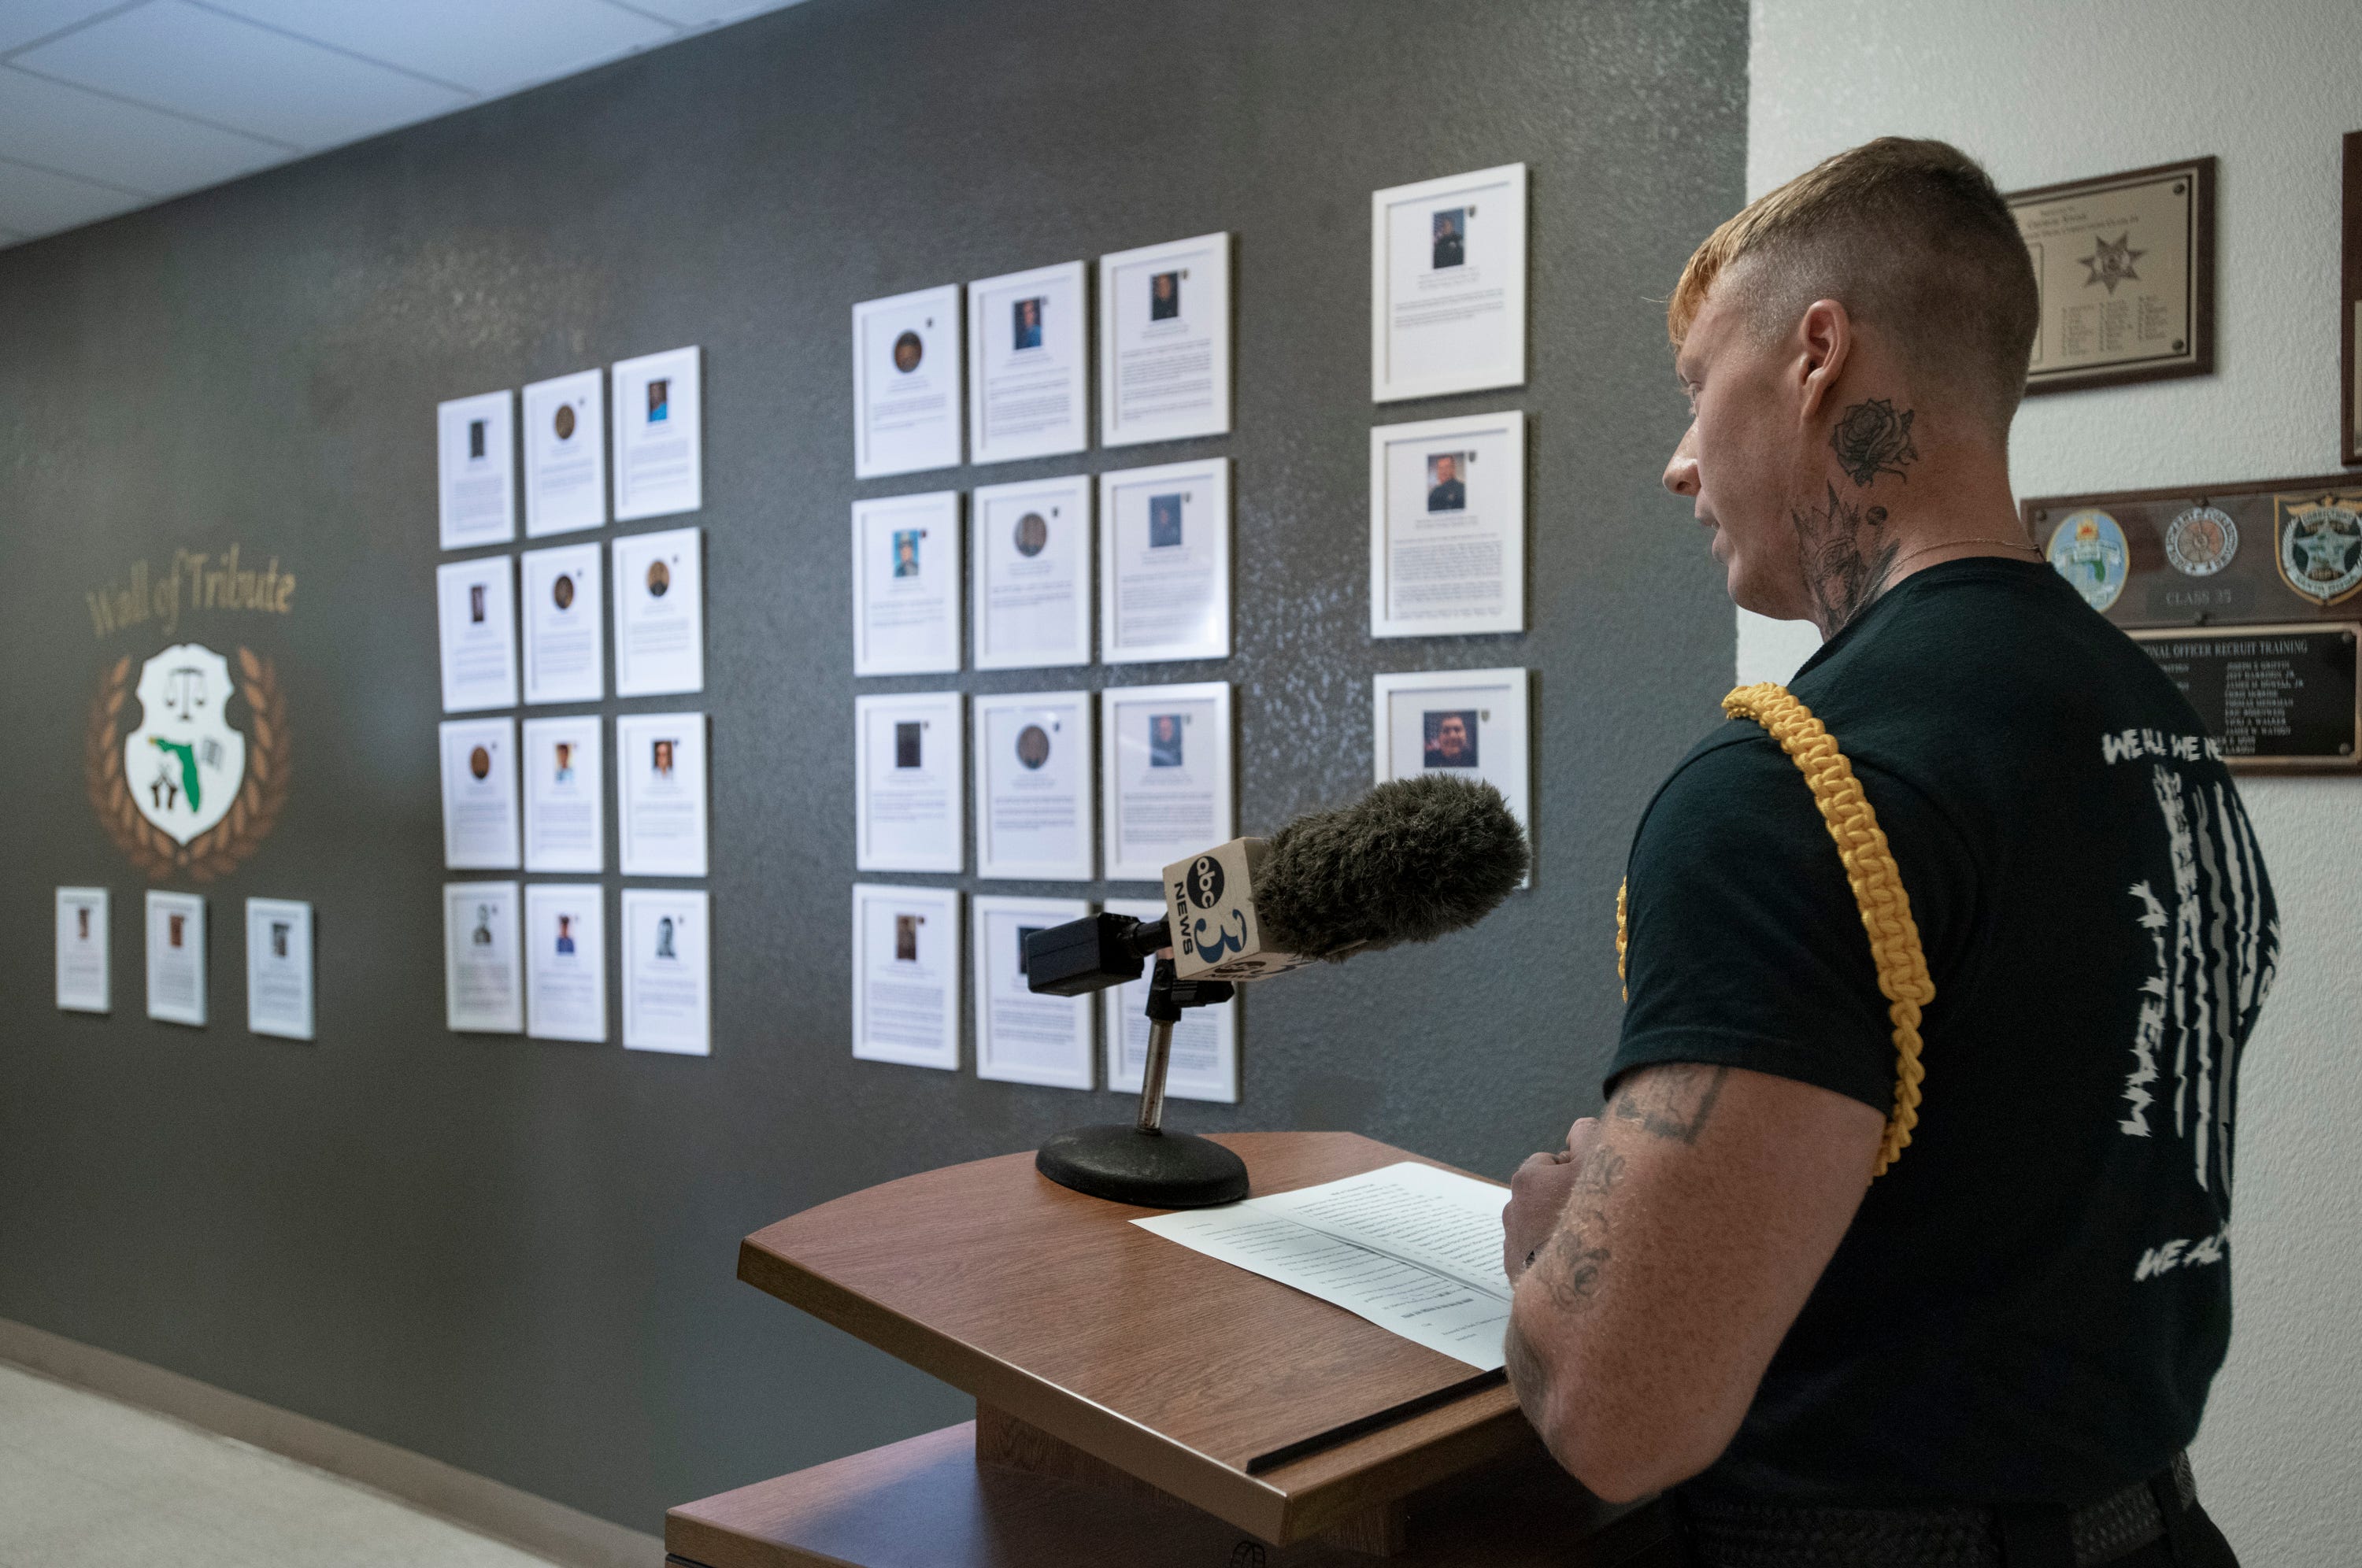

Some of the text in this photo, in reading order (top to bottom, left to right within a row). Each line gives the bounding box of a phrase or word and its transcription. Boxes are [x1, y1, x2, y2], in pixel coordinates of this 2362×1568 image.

[85, 559, 150, 638] Wall
[182, 542, 296, 614] Tribute
[2173, 642, 2212, 658] OFFICER
[2215, 641, 2256, 656] RECRUIT
[2258, 639, 2308, 655] TRAINING
[1196, 856, 1216, 908] abc
[1174, 881, 1194, 955] NEWS
